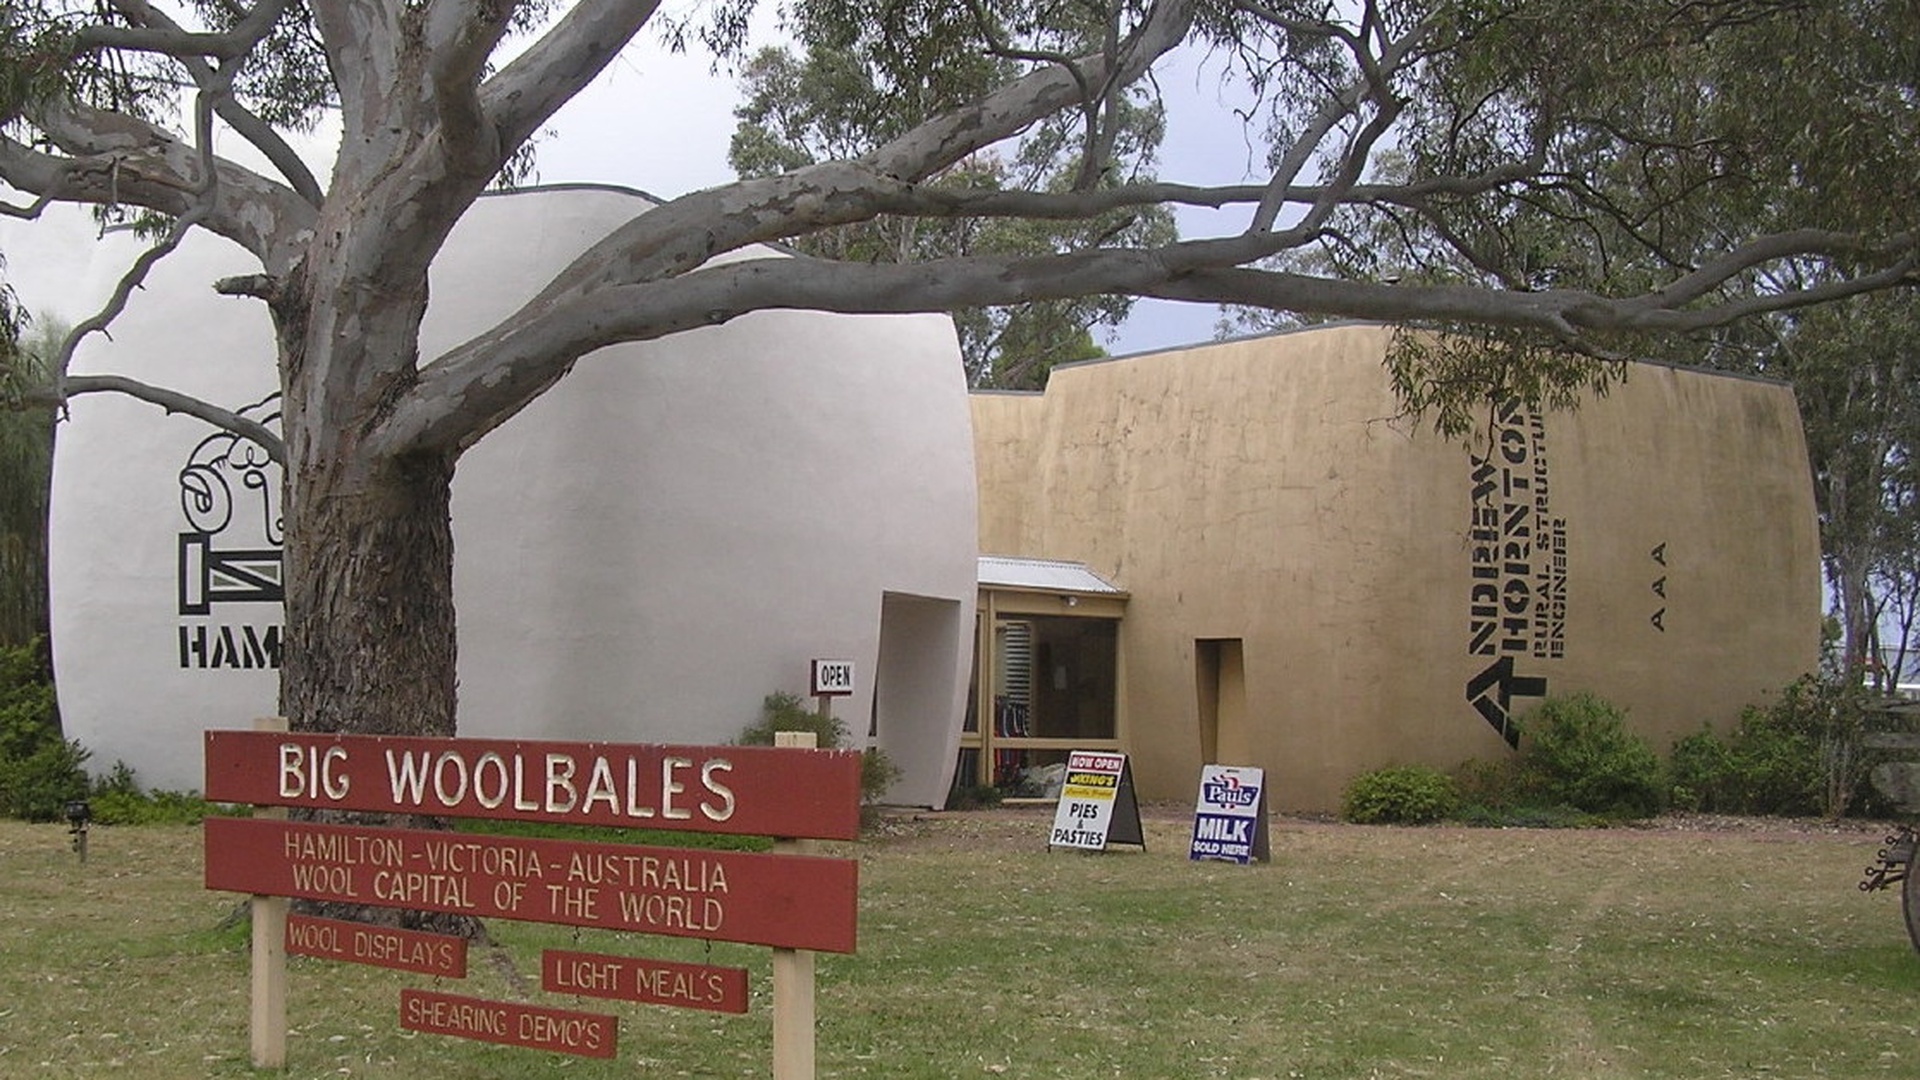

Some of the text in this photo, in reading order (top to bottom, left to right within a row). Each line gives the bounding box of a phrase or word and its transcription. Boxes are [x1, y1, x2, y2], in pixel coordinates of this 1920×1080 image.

[1550, 518, 1567, 659] ENGINEER
[1533, 565, 1550, 658] RURAL
[179, 626, 286, 669] HAM
[821, 665, 850, 686] OPEN
[1072, 756, 1119, 770] NOW OPEN
[279, 743, 735, 821] BIG WOOLBALES
[1208, 785, 1252, 803] Pauls
[1069, 803, 1098, 819] PIES
[1053, 829, 1103, 845] PASTIES
[1197, 817, 1249, 842] MILK
[1193, 840, 1249, 856] SOLD HERE
[293, 864, 723, 931] WOOL CAPITAL OF THE WORLD
[289, 922, 343, 952] WOOL
[557, 959, 723, 1002] LIGHT MEAL'S
[408, 998, 600, 1049] SHEARING DEMO'S
